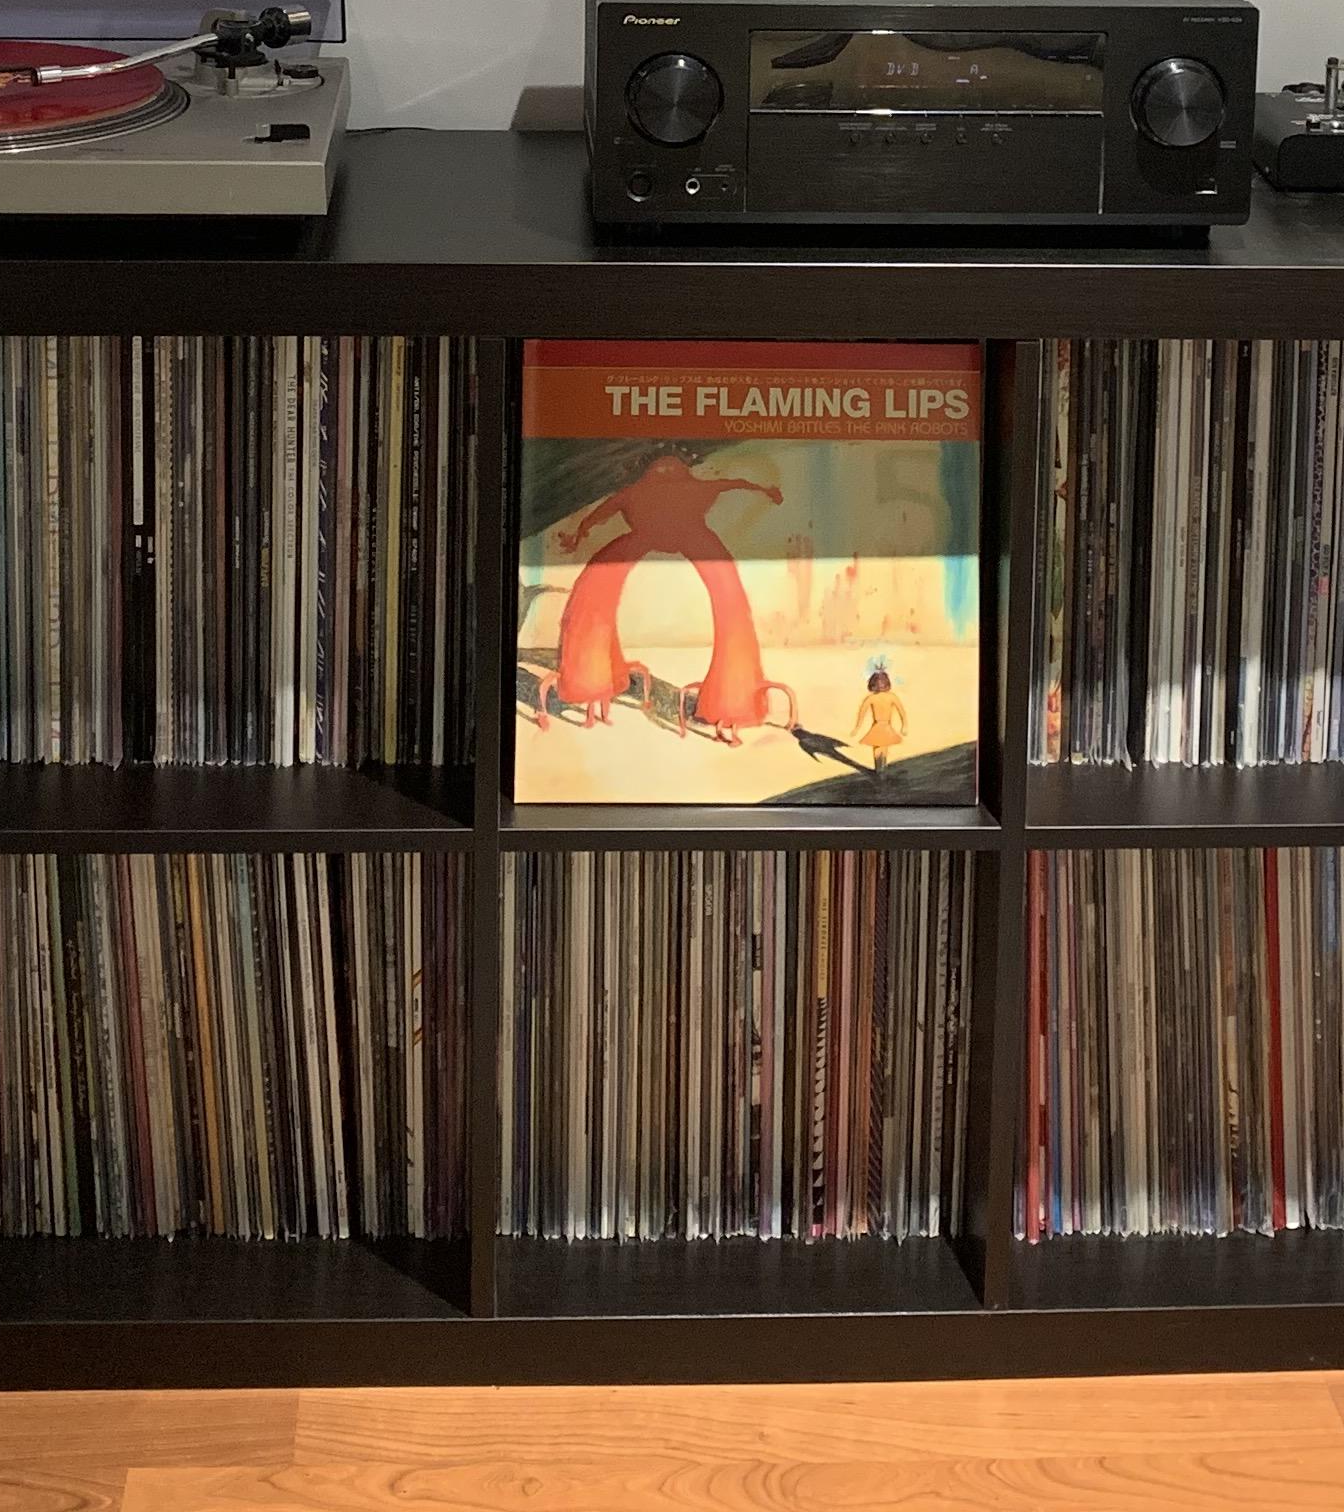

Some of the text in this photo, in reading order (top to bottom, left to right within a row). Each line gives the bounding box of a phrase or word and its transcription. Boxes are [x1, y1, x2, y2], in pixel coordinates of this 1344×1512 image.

[622, 14, 681, 25] Pioneer
[287, 375, 296, 393] THE
[287, 397, 296, 422] DEAR
[605, 386, 970, 420] THE FLAMING LIPS
[724, 420, 969, 435] YOSHIMI BATTLES THE PINK ROBOTS
[286, 426, 296, 464] HUNTER
[704, 884, 713, 917] SPOON
